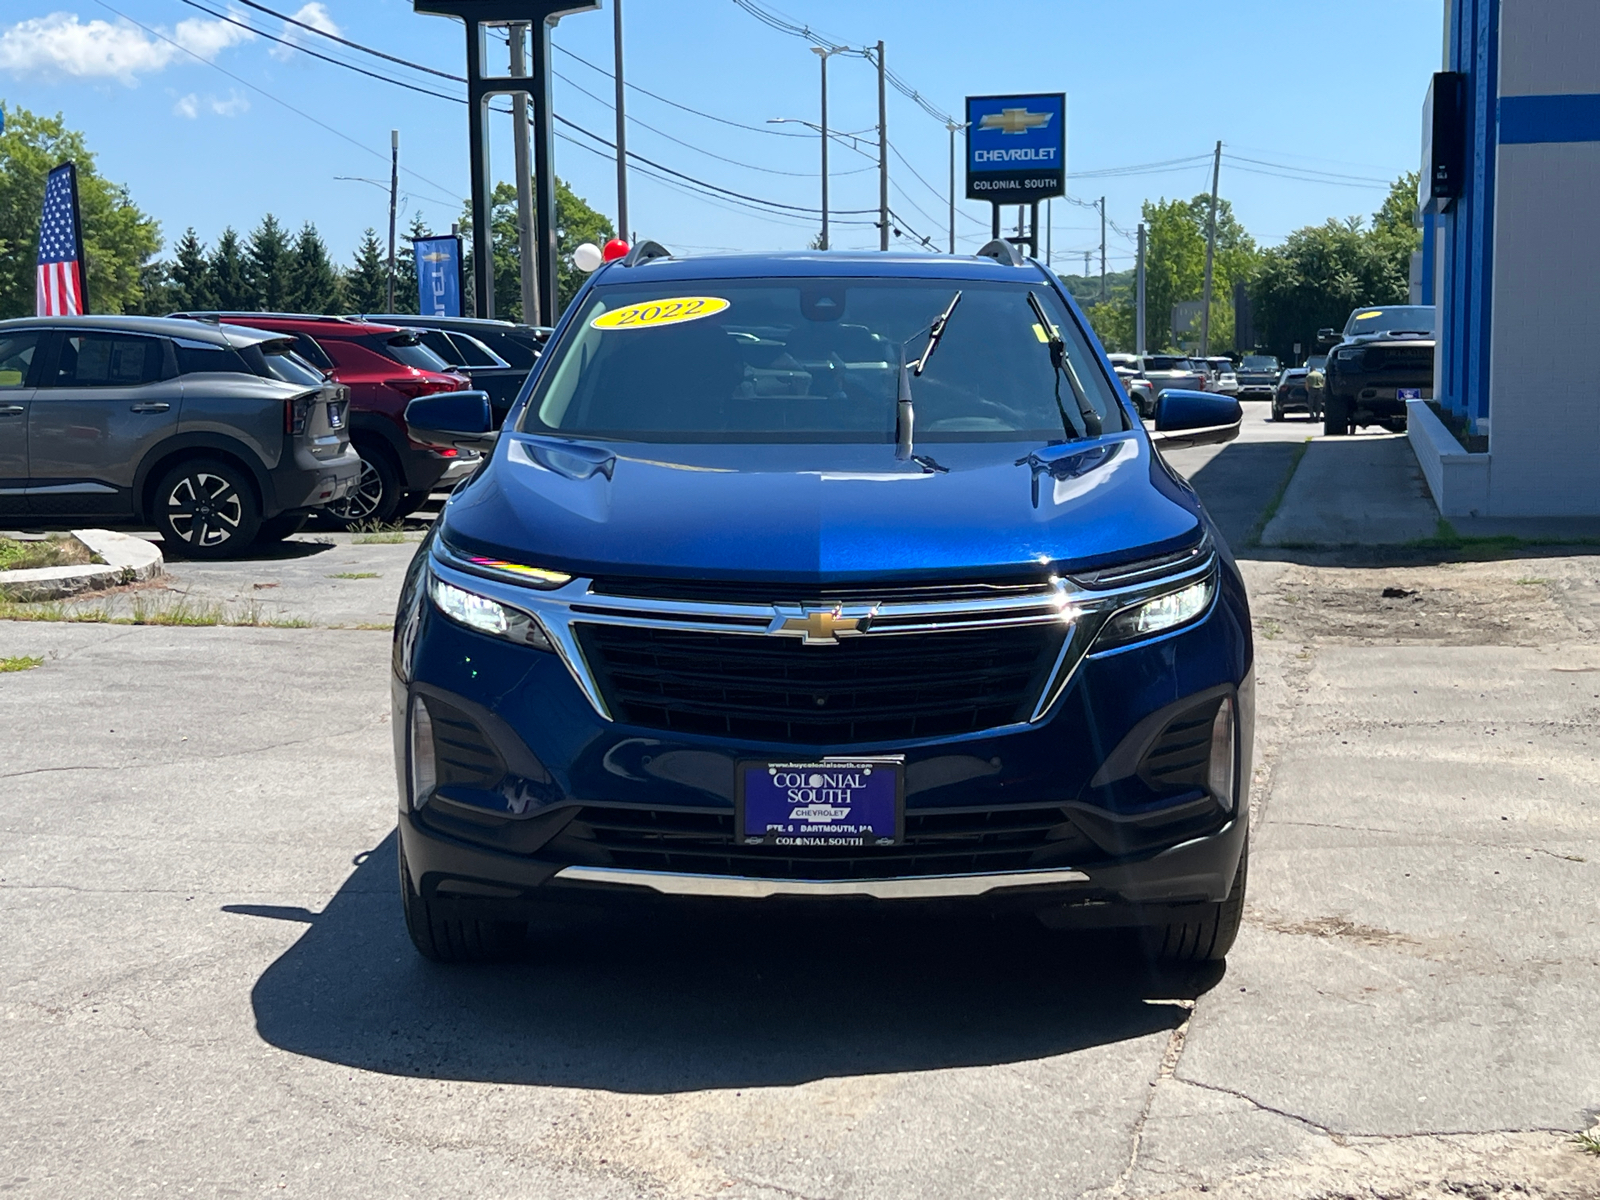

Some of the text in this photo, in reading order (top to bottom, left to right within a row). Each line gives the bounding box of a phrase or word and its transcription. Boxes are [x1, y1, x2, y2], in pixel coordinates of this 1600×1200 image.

[974, 147, 1056, 162] CHEVROLET
[973, 179, 1057, 190] COLONIAL SOUTH
[616, 300, 705, 326] 2022
[773, 773, 866, 788] COLONIAL
[787, 788, 851, 803] SOUTH
[795, 809, 844, 817] CHEVROLET
[775, 837, 863, 845] COLONIAL SOUTH
